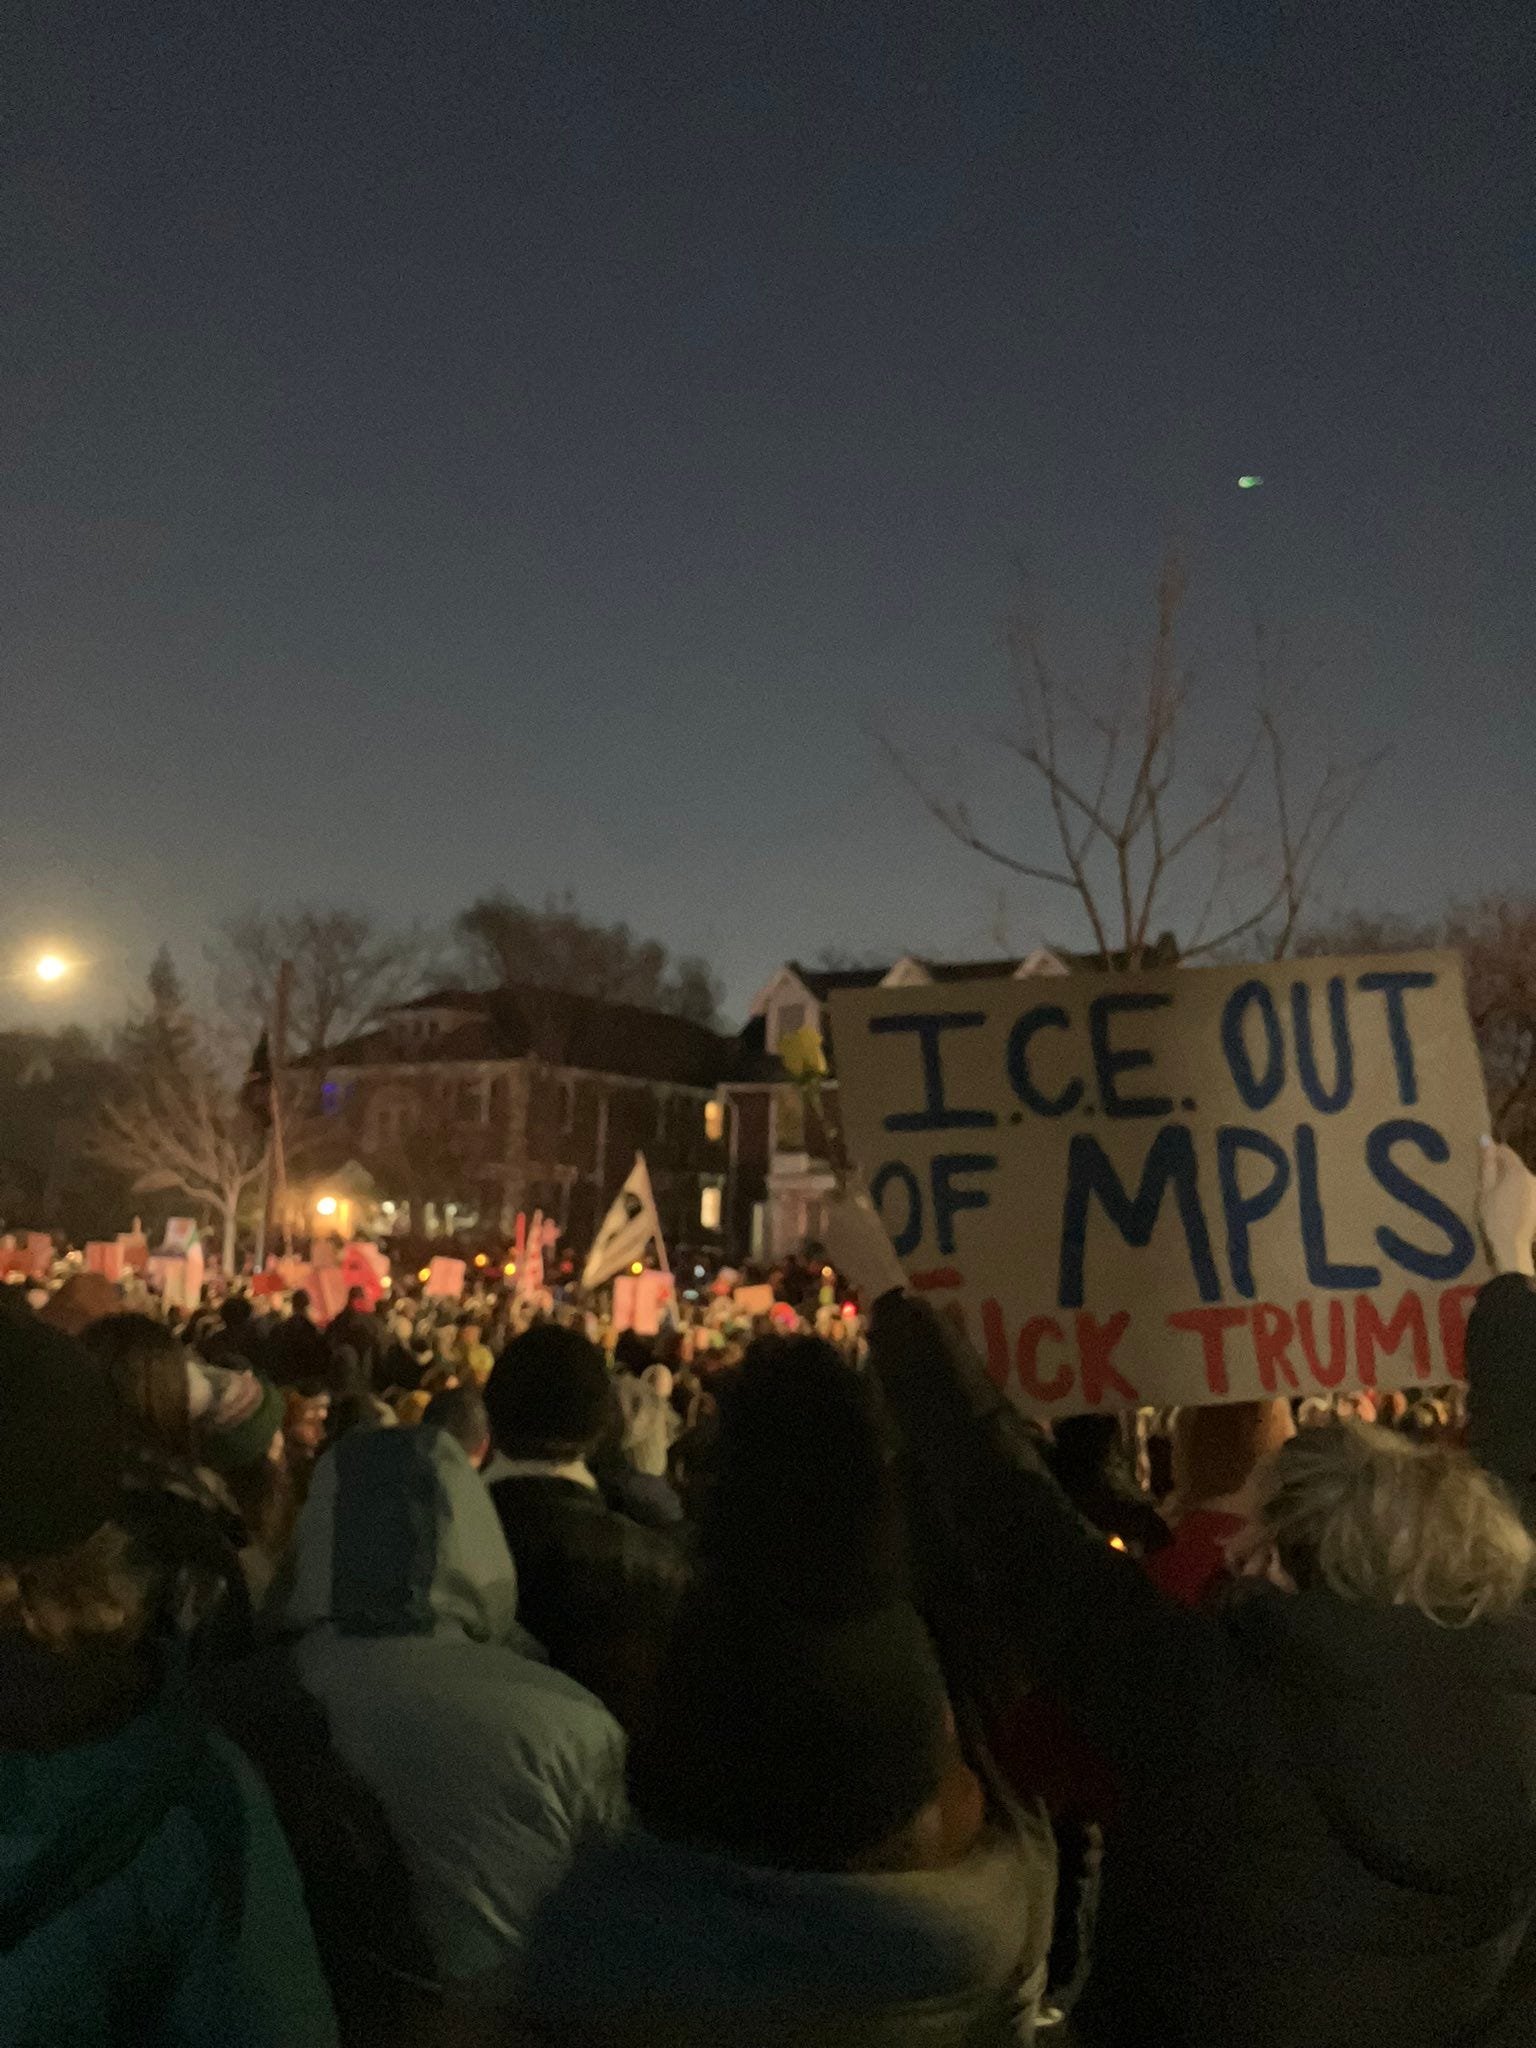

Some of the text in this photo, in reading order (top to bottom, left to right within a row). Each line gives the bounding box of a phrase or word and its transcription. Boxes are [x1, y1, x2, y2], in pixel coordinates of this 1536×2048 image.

[869, 972, 1436, 1132] I.C.E. OUT
[869, 1118, 1476, 1309] OF MPLS
